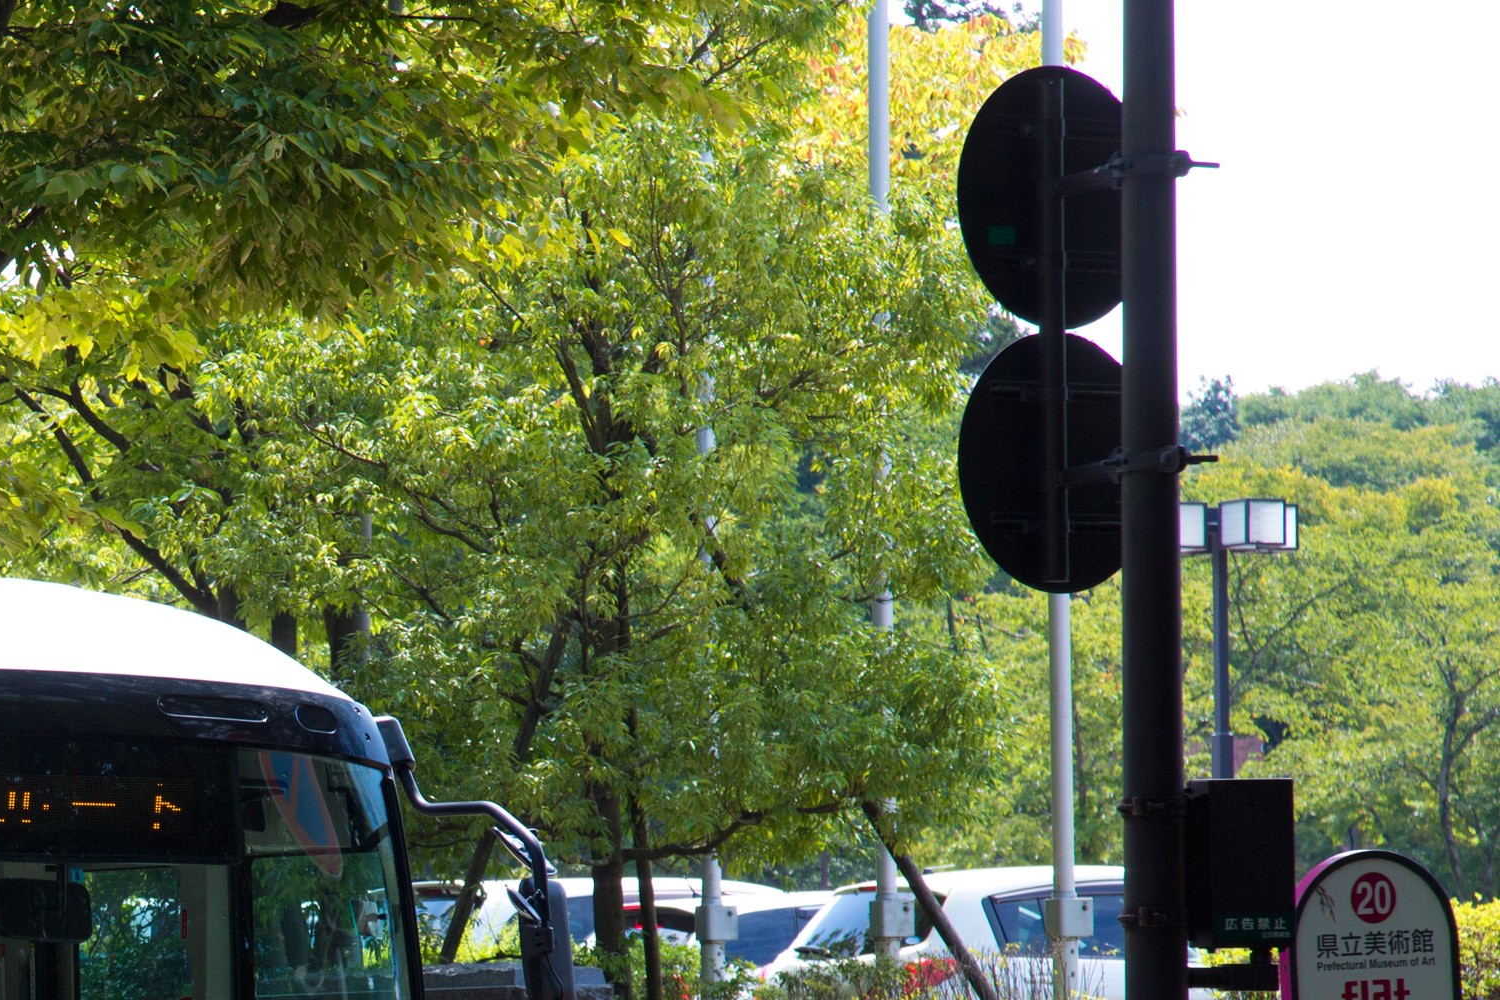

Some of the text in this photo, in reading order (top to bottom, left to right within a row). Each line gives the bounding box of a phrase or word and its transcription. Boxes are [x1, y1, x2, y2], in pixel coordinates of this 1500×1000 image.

[1356, 880, 1392, 915] 20
[1225, 917, 1287, 931] 広告禁止
[1317, 928, 1434, 959] 県立美術館
[1317, 956, 1436, 972] Prefectural Museum of Art
